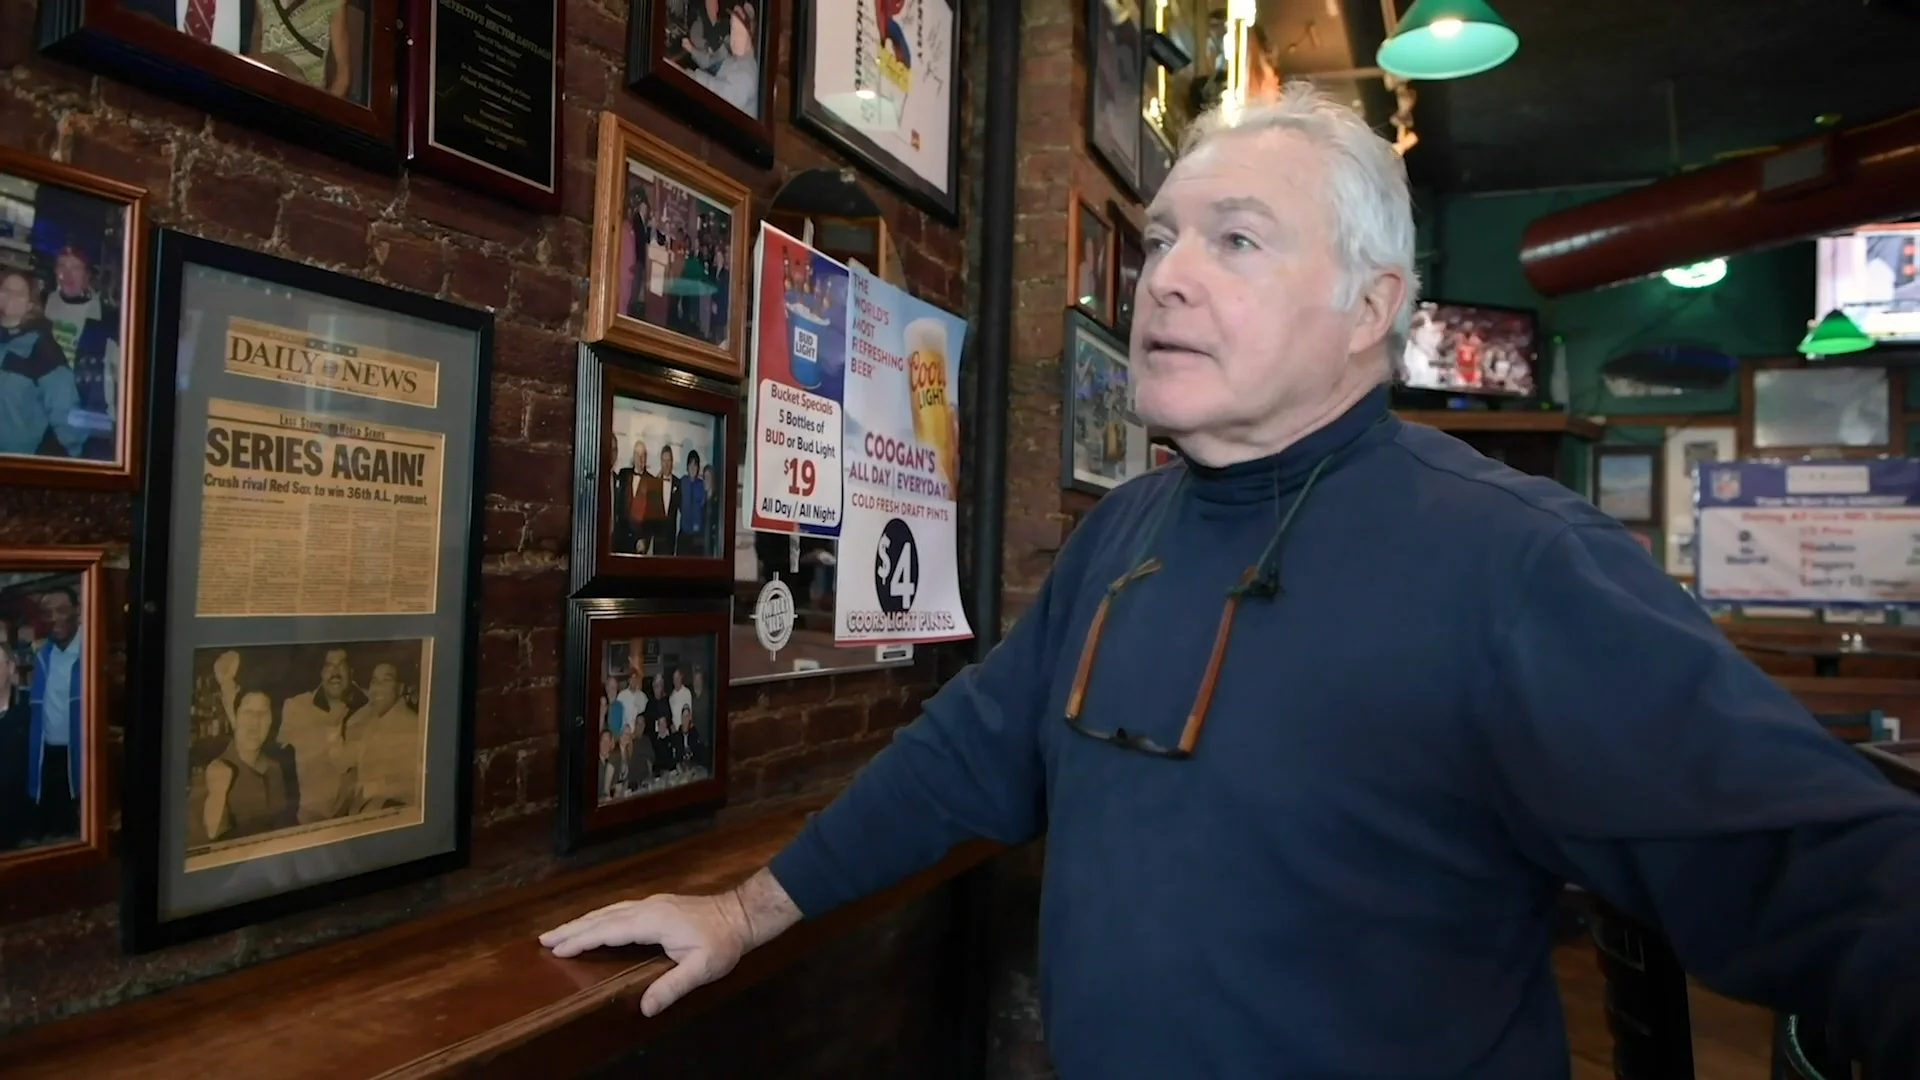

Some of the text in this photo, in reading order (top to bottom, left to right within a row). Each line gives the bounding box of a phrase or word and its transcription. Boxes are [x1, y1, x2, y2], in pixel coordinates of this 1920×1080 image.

[484, 18, 517, 42] HECTOR
[516, 35, 552, 60] SANTIAGO
[853, 273, 869, 295] THE
[854, 298, 890, 326] WORLD'S
[798, 332, 814, 346] BUD
[852, 317, 875, 338] MOST
[229, 335, 320, 376] DAILY
[341, 358, 418, 394] NEWS
[795, 341, 816, 358] LIGHT
[851, 336, 904, 372] REFRESHING
[771, 384, 833, 415] Bucket Specials
[918, 388, 945, 410] LIGHT
[779, 409, 825, 434] 5 Bottles of
[206, 427, 425, 487] SERIES AGAIN!
[765, 429, 836, 459] BUD or Bud Light
[864, 431, 936, 474] COOGAN'S
[204, 472, 428, 506] Crush rival Red Sox to win 36th A.L. pennant
[784, 457, 816, 497] $19
[849, 461, 948, 499] ALL DAY EVERYDAY
[761, 497, 773, 512] All
[774, 500, 792, 518] Day
[799, 504, 811, 517] All
[813, 507, 836, 523] Night
[851, 493, 949, 521] COLD FRESH DRAFT PINTS
[877, 532, 915, 610] $4
[847, 610, 955, 633] COORS LIGHT PINTS
